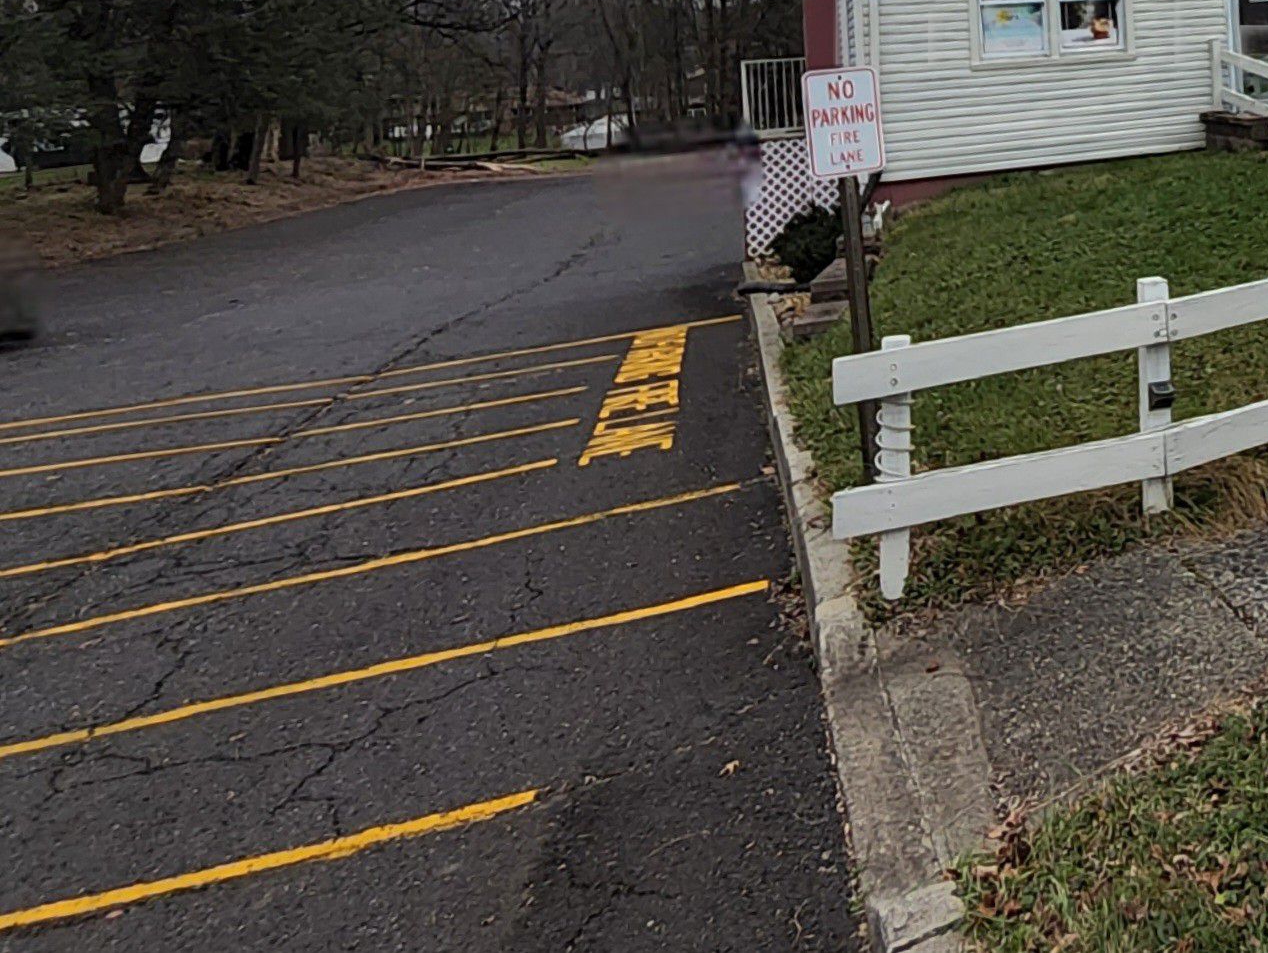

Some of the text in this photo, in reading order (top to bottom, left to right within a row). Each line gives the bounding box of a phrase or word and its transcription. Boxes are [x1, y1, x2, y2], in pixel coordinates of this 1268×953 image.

[827, 80, 854, 100] NO
[811, 103, 875, 128] PARKING
[830, 130, 861, 146] FIRE
[830, 149, 864, 165] LANE
